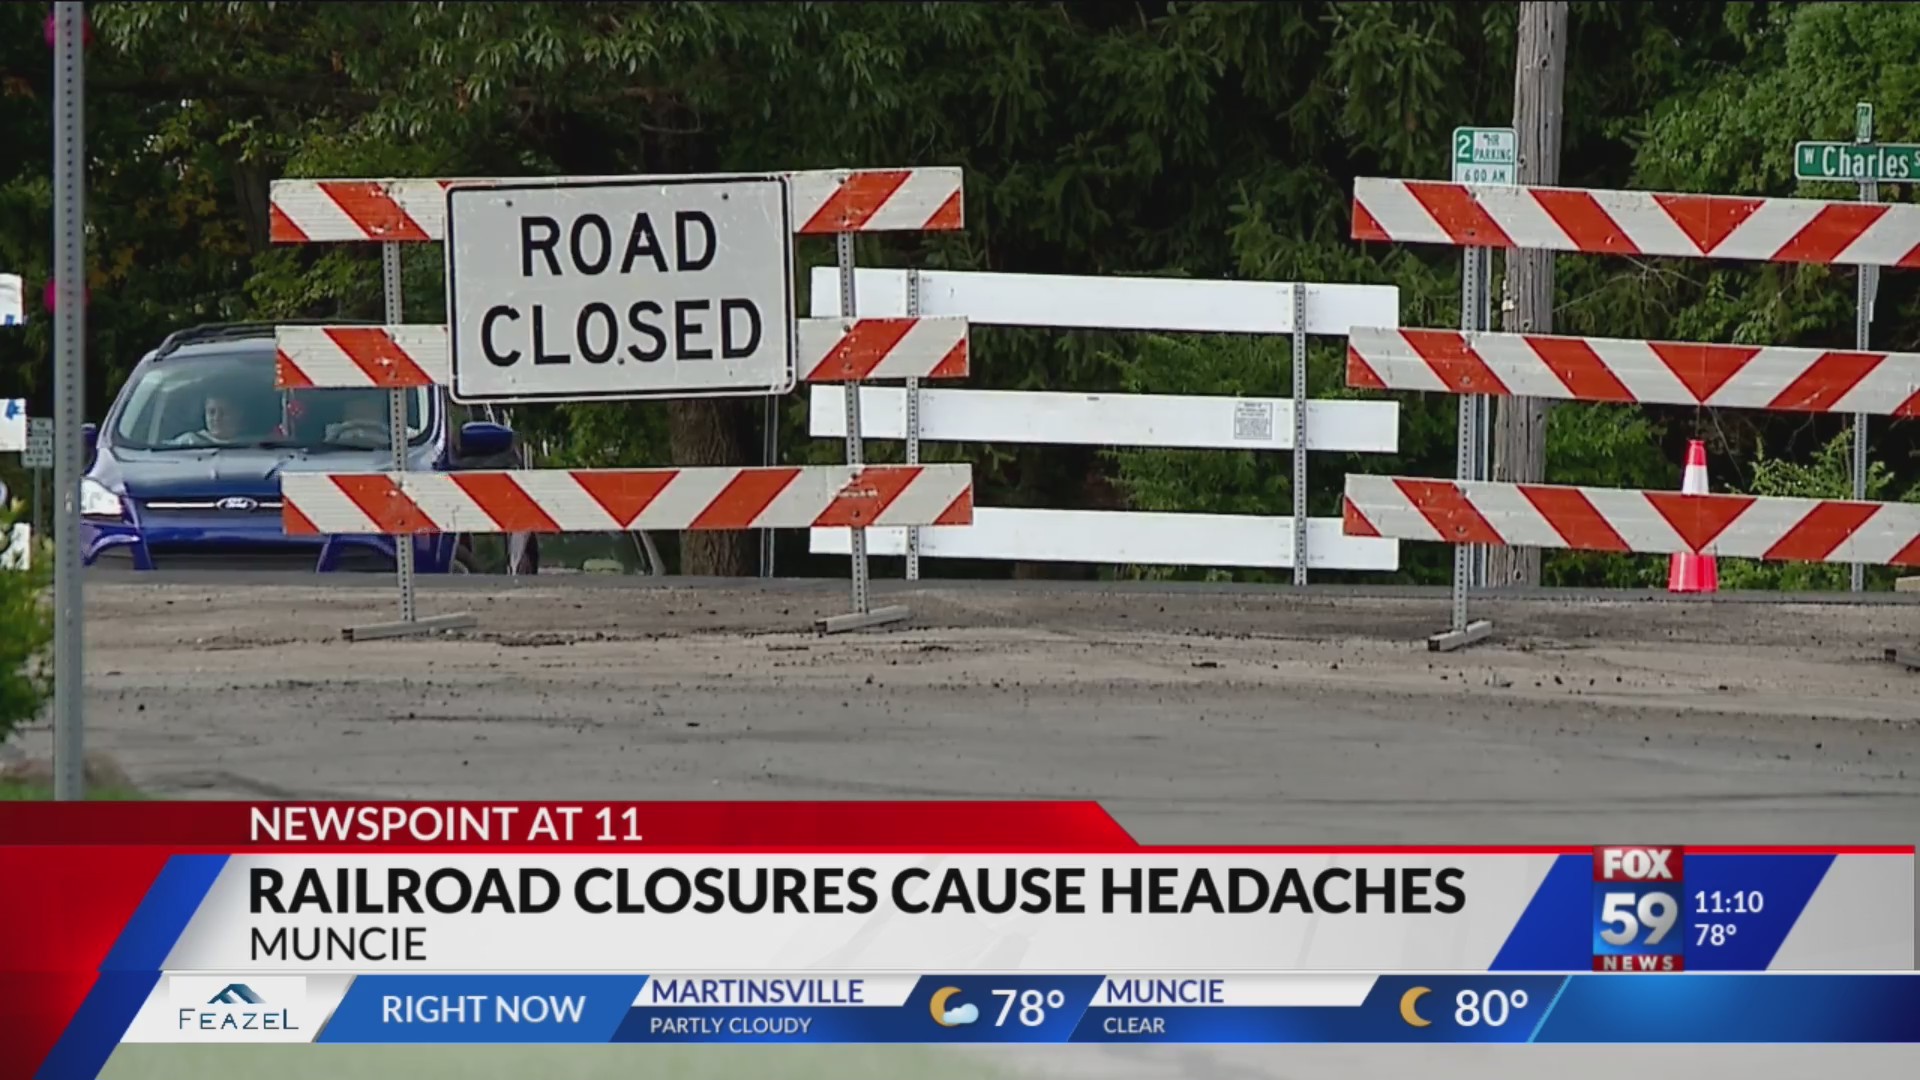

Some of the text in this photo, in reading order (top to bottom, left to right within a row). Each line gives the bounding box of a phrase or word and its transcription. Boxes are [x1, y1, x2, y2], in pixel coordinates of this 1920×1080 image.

[1458, 134, 1471, 158] 2
[1474, 148, 1512, 160] PARKING
[1804, 148, 1815, 164] W
[1822, 146, 1909, 178] Charles
[521, 210, 717, 277] ROAD
[481, 298, 762, 367] CLOSED
